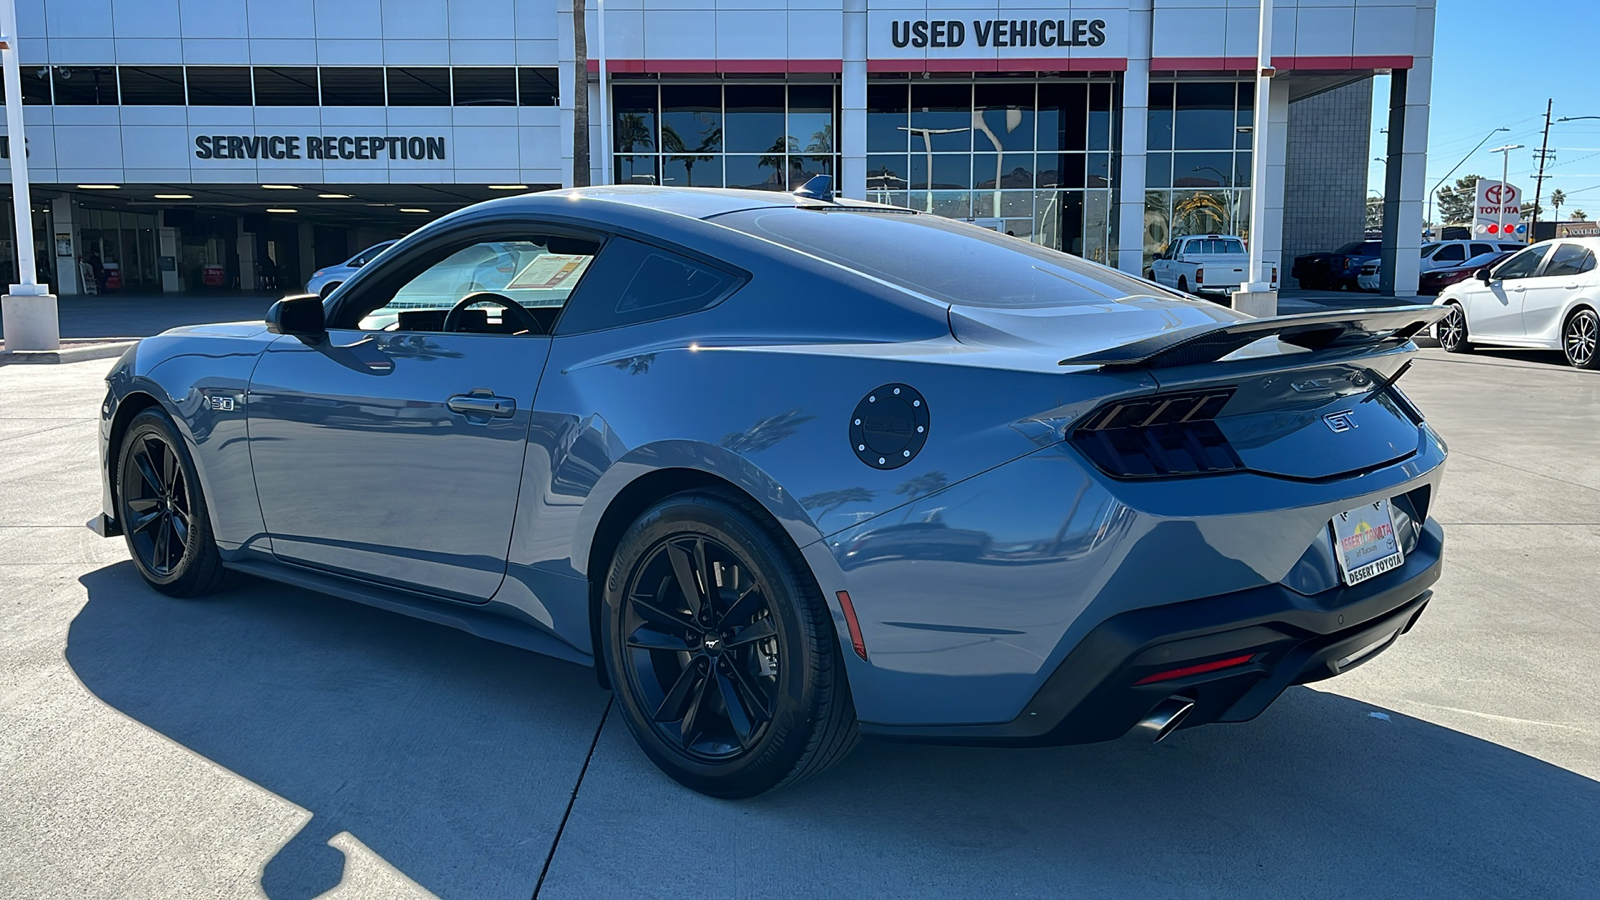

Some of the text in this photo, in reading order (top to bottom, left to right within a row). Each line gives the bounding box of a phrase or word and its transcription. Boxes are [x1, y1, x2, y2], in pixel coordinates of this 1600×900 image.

[892, 19, 1106, 48] USED VEHICLES
[195, 135, 445, 160] SERVICE RECEPTION
[1322, 409, 1359, 433] GT
[1364, 523, 1392, 542] TOYOTA
[1349, 554, 1402, 584] DESERT TOYOTA
